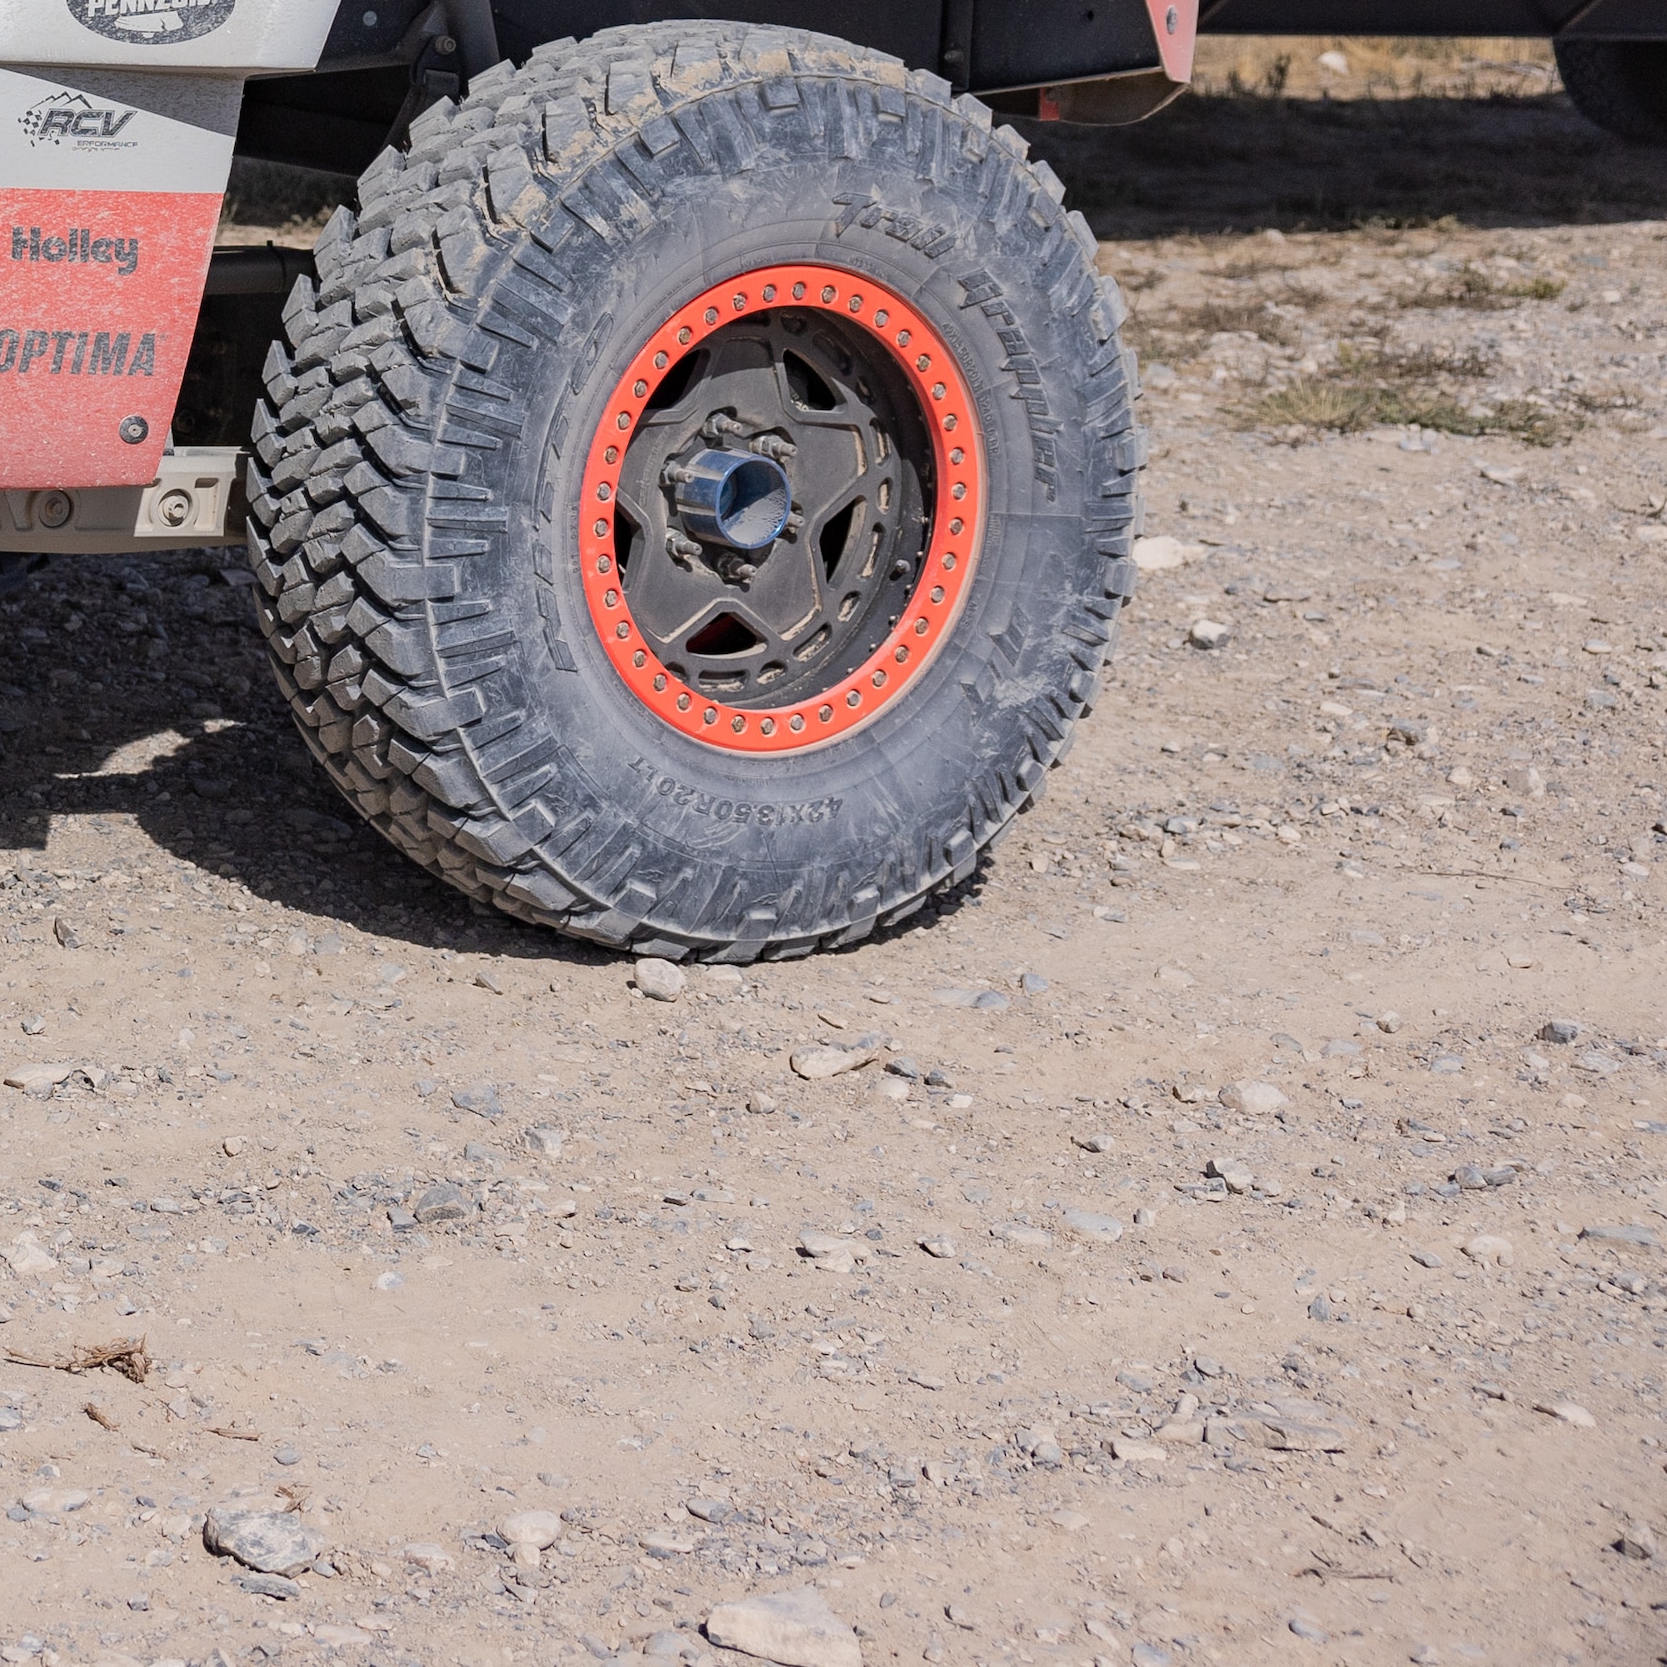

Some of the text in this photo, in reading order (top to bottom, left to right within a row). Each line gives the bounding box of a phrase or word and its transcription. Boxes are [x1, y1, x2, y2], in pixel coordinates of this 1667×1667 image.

[38, 107, 138, 139] RCV
[76, 139, 139, 148] ERFORMANCE
[10, 226, 139, 276] Holley
